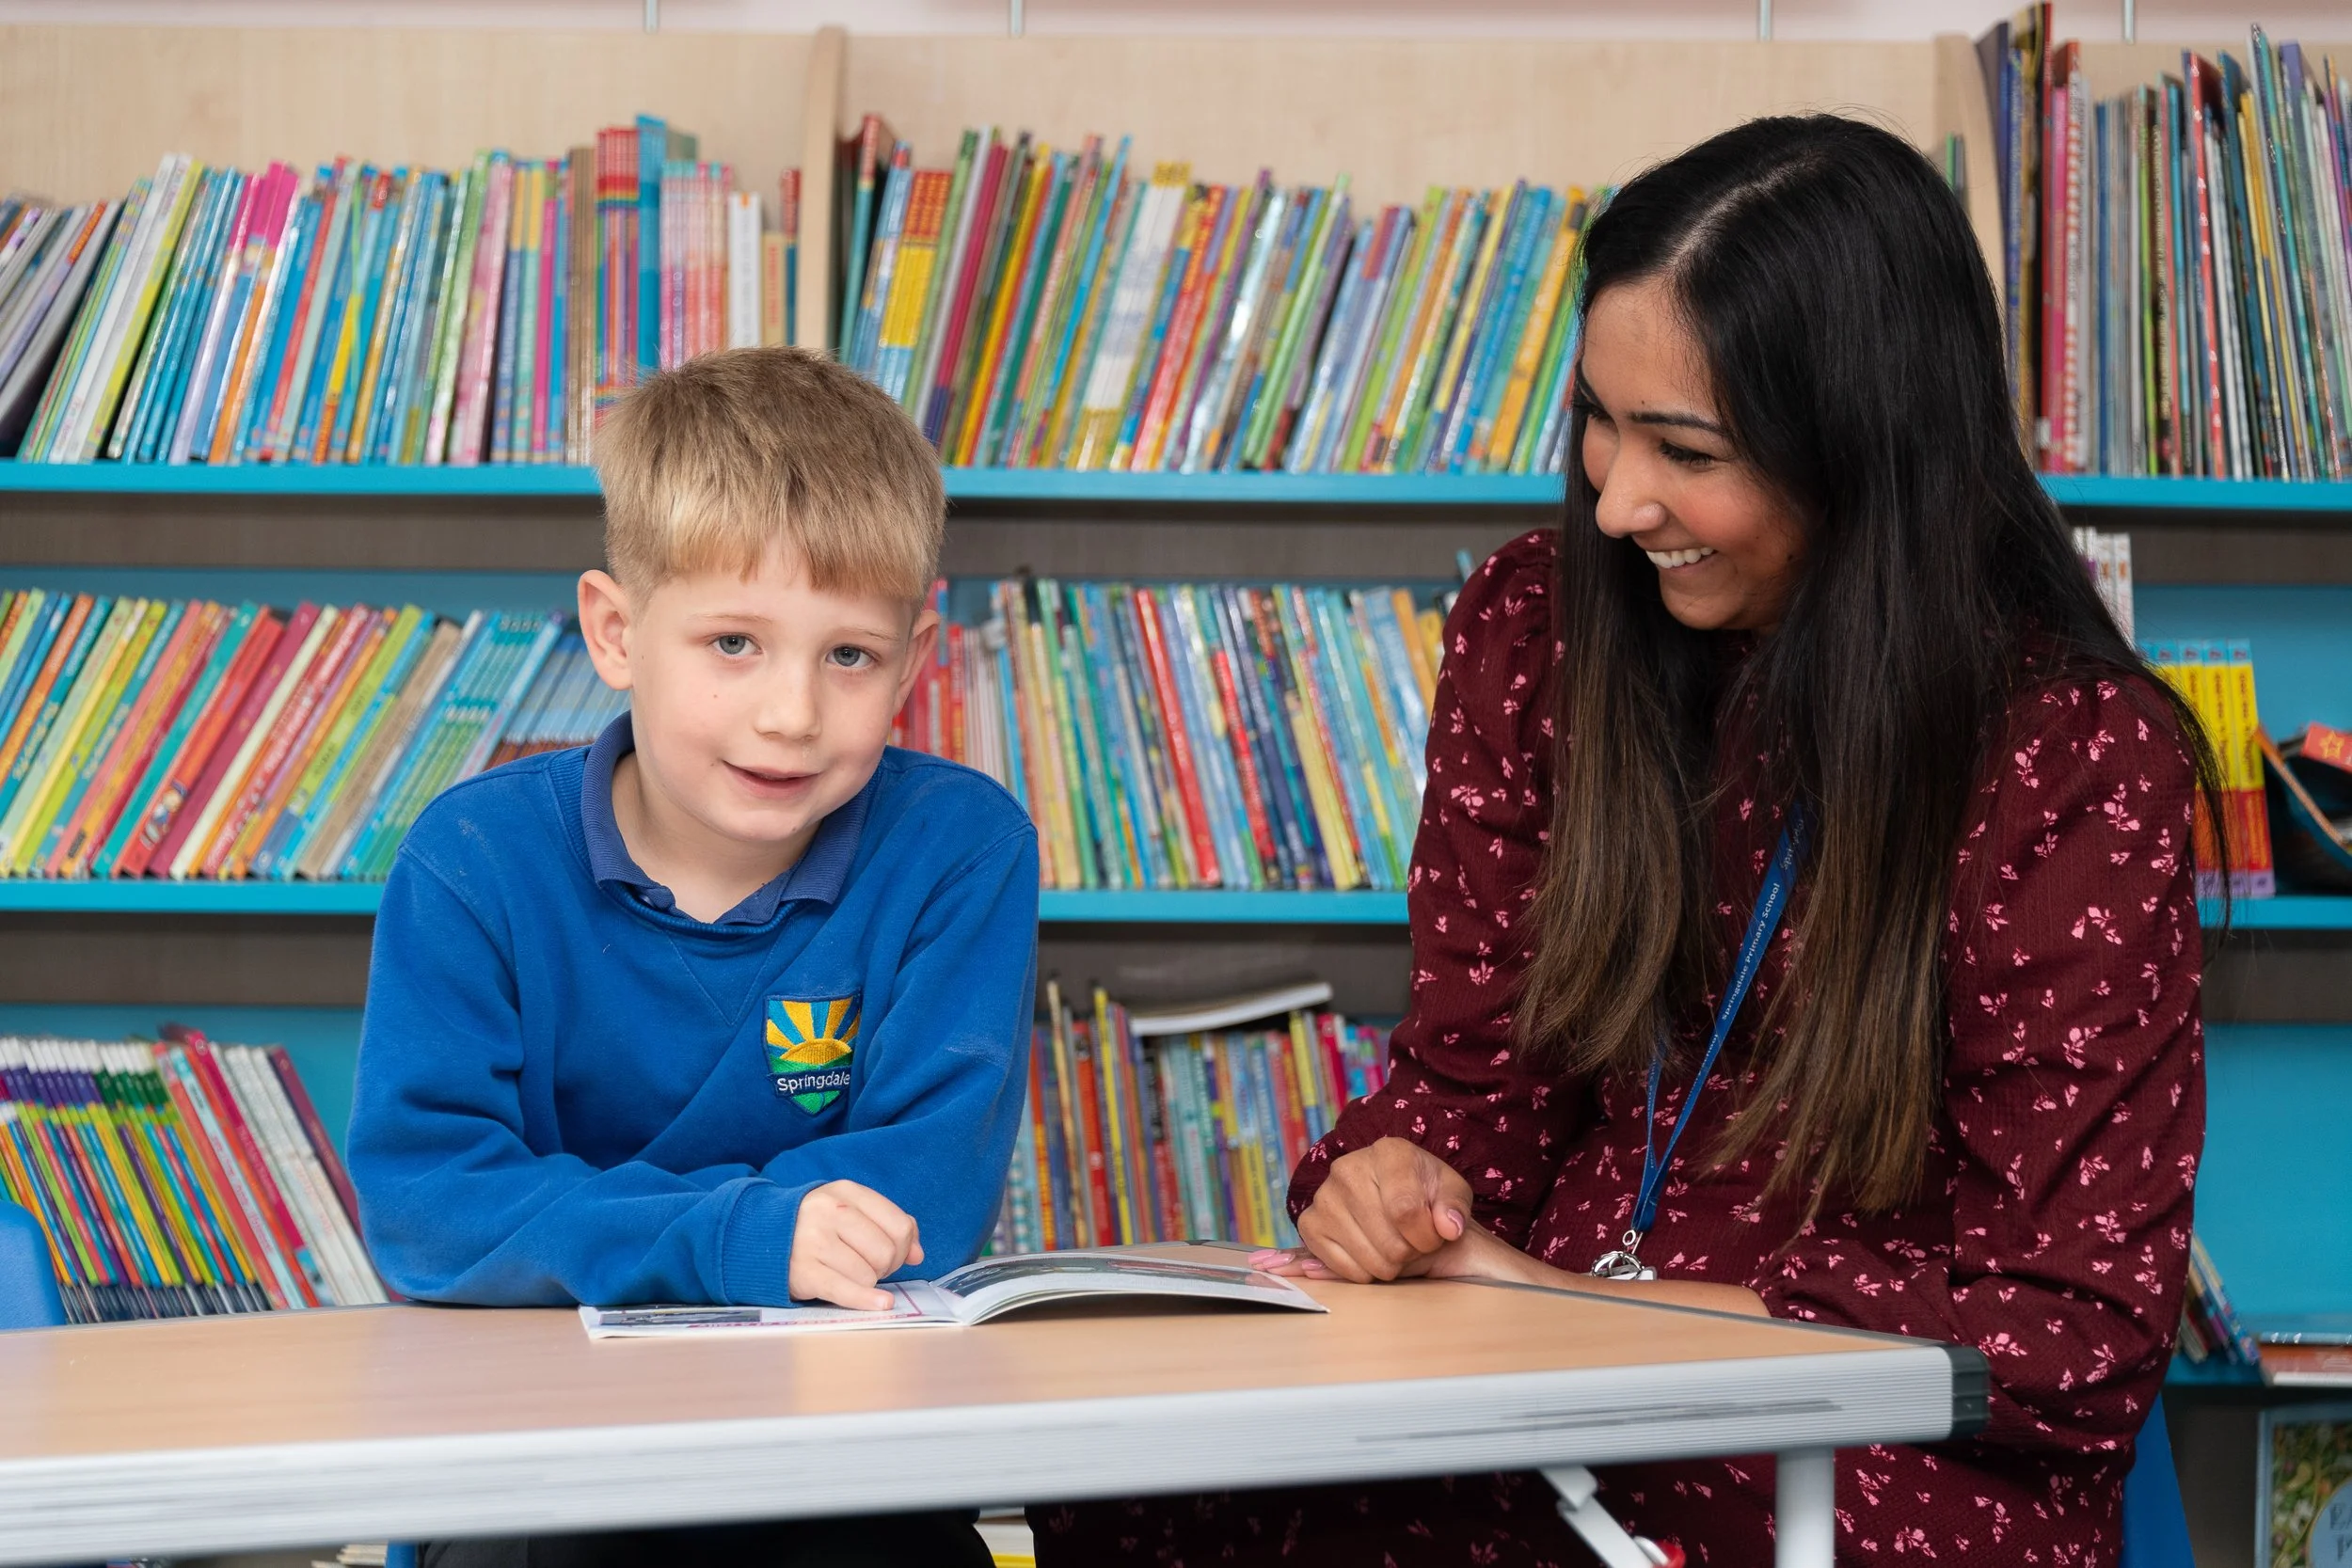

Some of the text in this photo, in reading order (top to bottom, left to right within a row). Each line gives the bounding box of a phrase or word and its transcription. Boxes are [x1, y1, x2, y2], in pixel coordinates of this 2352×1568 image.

[1722, 882, 1781, 1021] Springdale Primary School
[776, 1070, 850, 1094] Springdale
